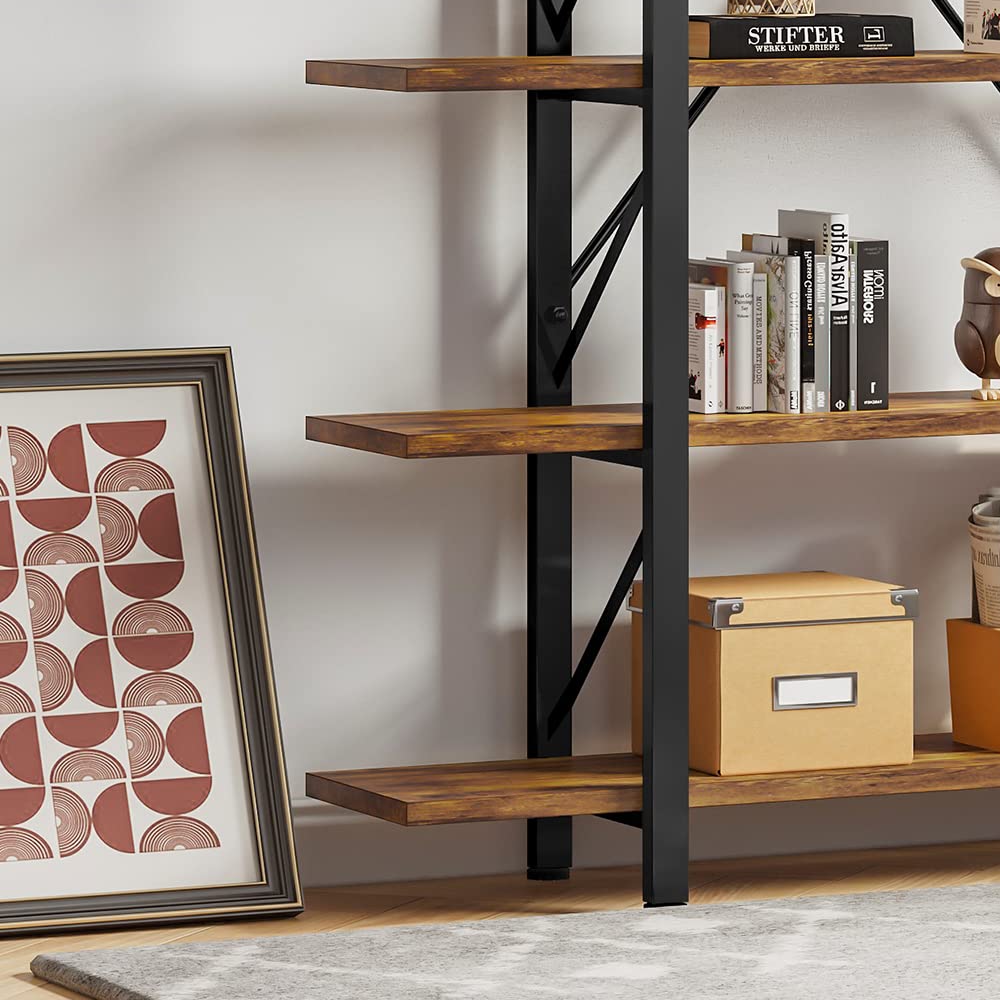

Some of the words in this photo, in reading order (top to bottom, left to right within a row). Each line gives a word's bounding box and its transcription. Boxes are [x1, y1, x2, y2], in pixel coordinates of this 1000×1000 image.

[747, 26, 845, 45] STIFTER
[755, 45, 786, 53] WERKE
[787, 44, 807, 52] UND
[808, 43, 840, 51] BRIEFE
